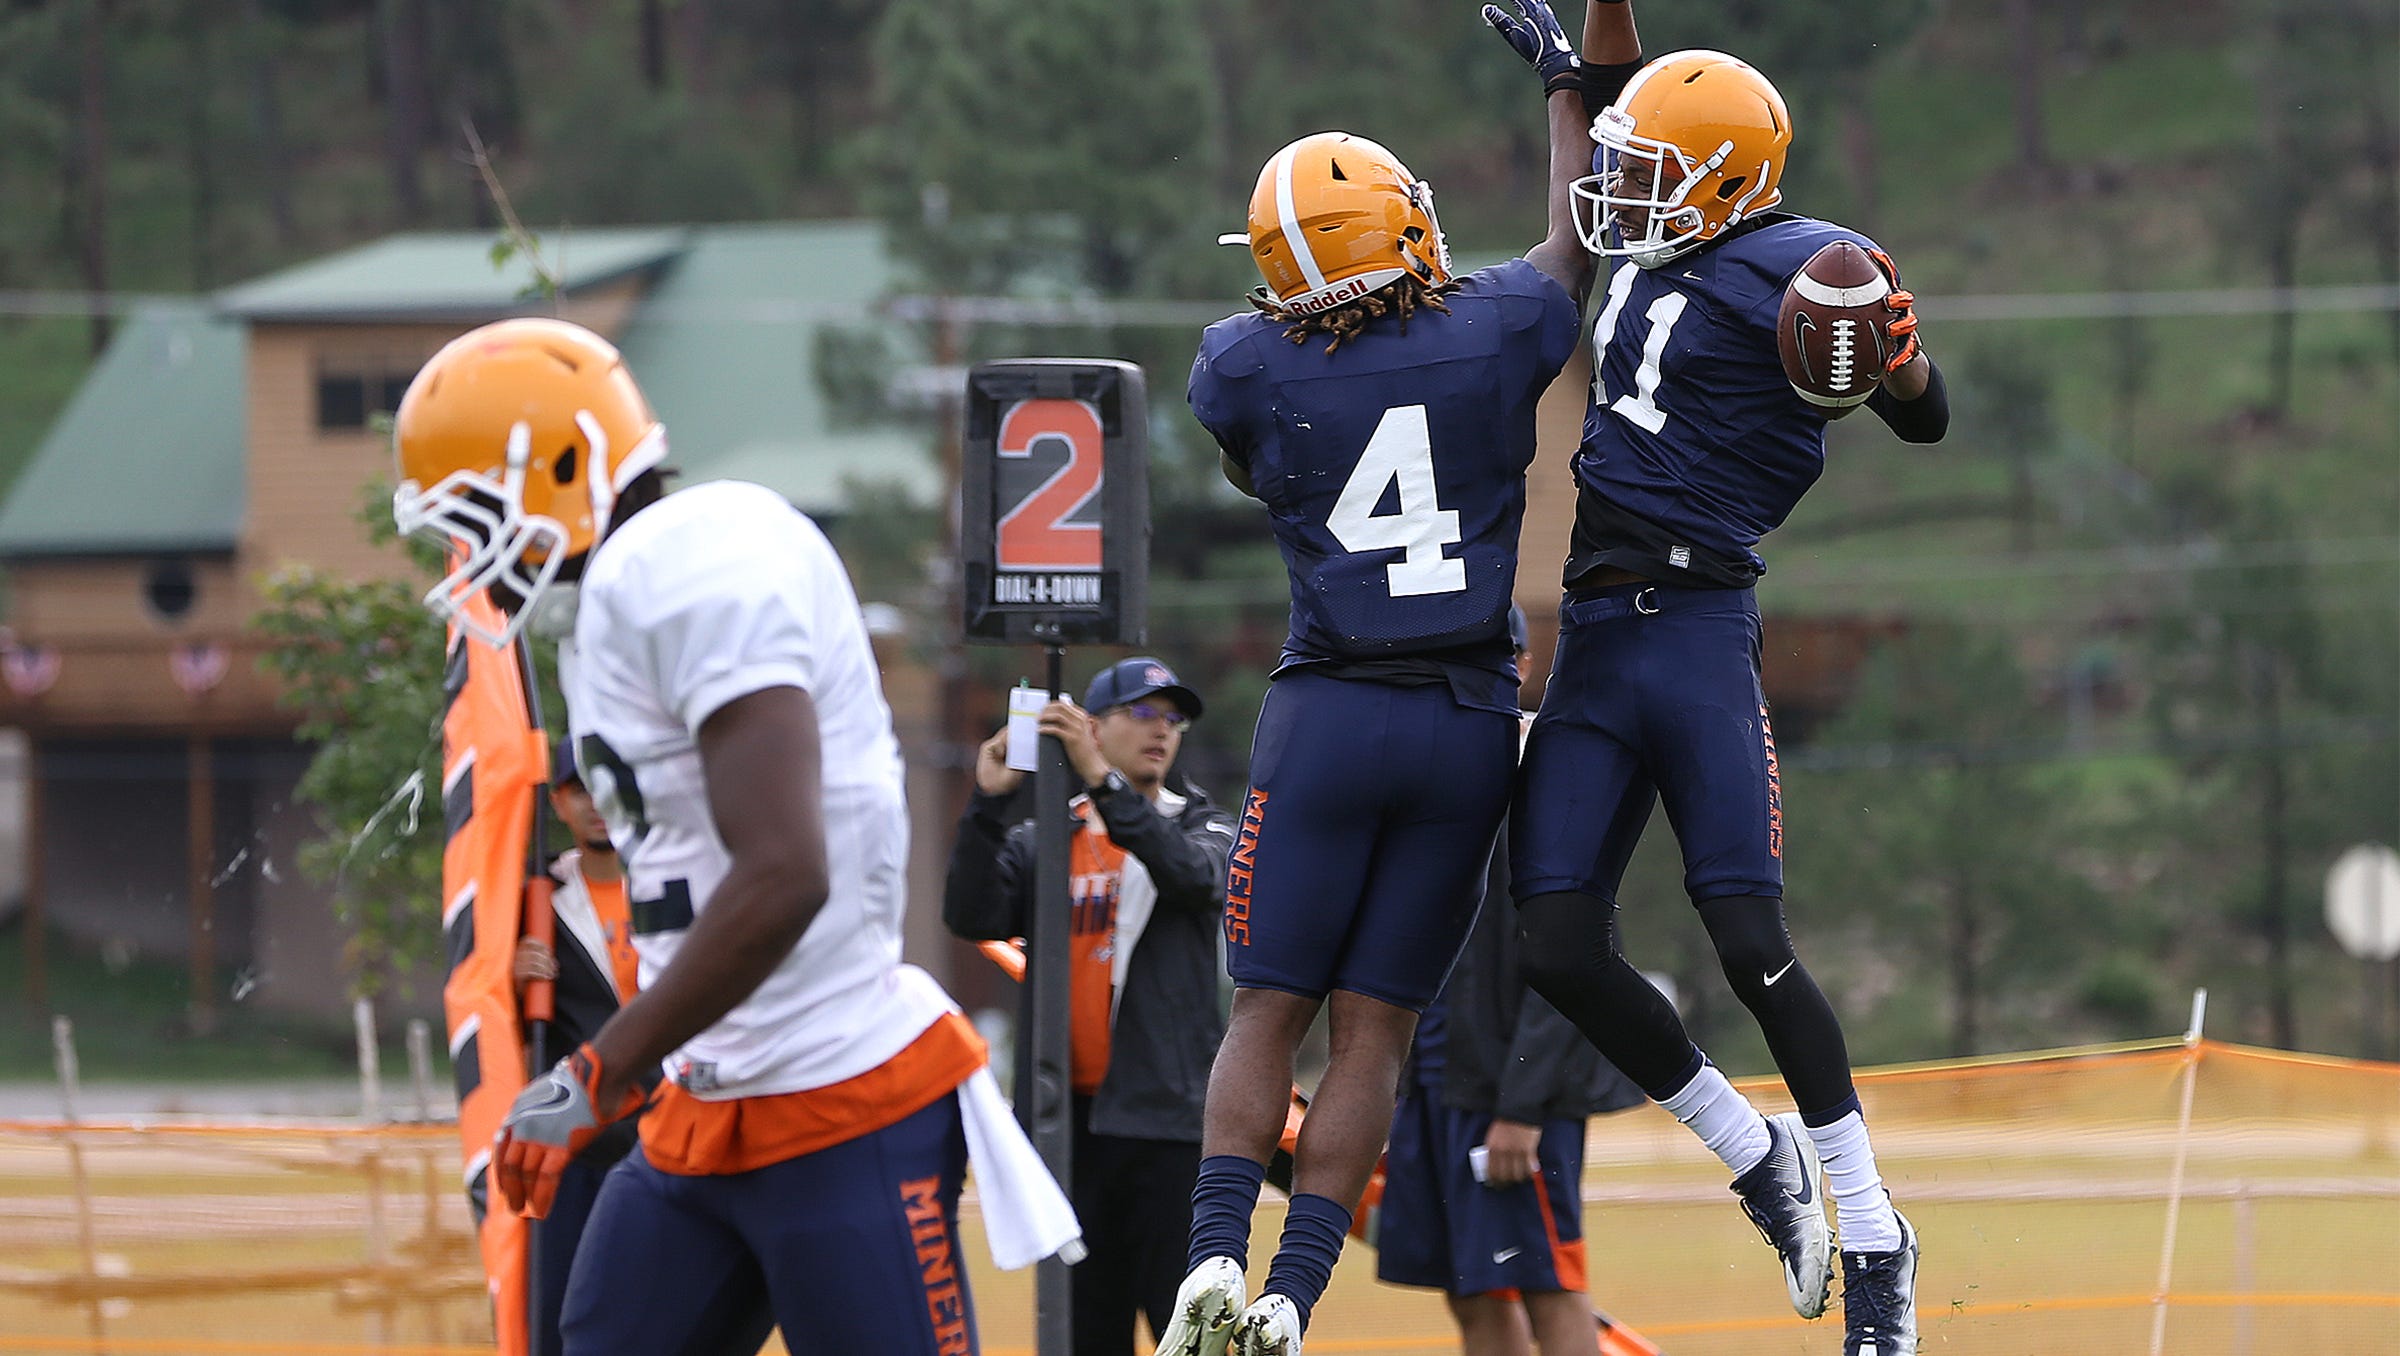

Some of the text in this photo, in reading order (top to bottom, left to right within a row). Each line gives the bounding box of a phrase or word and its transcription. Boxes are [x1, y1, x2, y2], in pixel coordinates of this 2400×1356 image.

[1288, 278, 1370, 316] Riddell
[1592, 260, 1688, 435] 11
[996, 398, 1105, 571] 2
[1325, 403, 1467, 598] 4
[1224, 786, 1270, 947] MINERS
[900, 1174, 972, 1356] MINER
